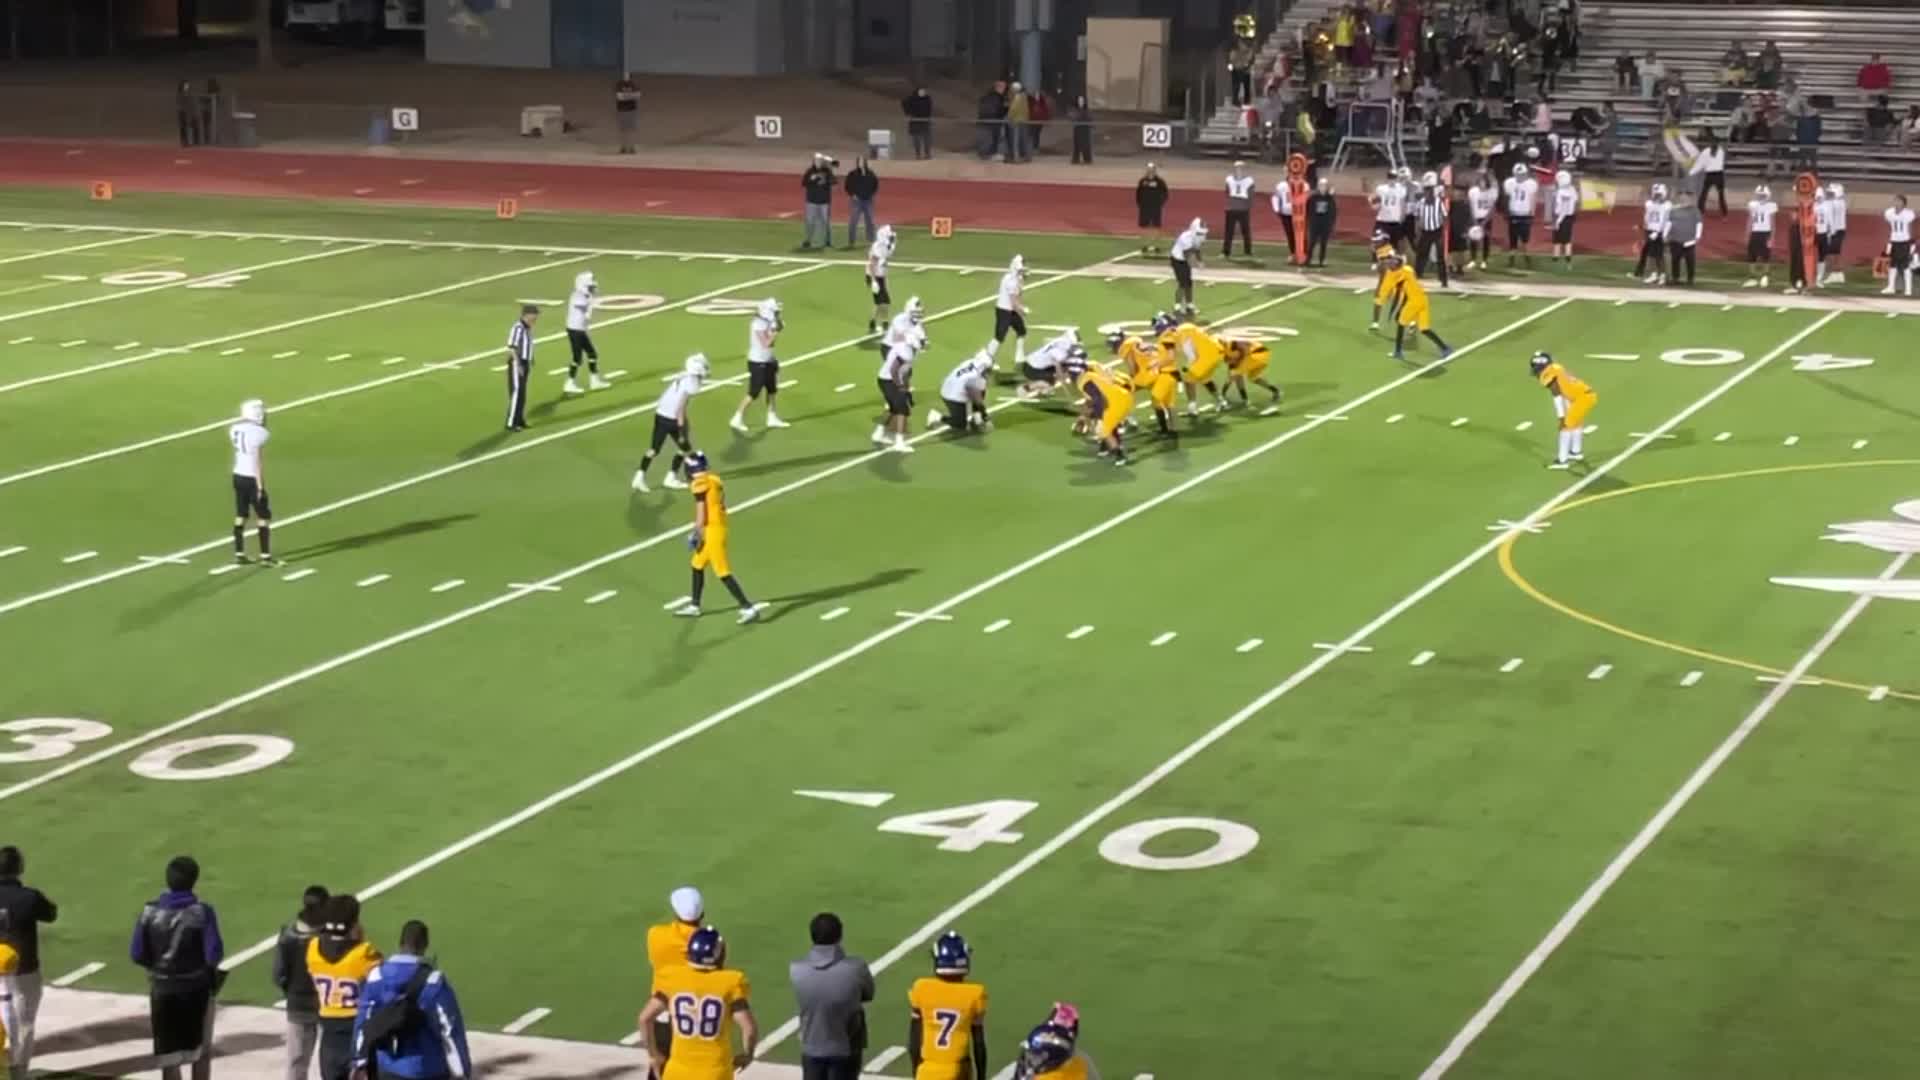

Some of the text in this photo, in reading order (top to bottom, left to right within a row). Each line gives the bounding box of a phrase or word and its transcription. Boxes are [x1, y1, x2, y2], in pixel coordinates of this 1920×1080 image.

[399, 111, 411, 127] G
[760, 119, 778, 135] 10
[1146, 128, 1168, 144] 20
[0, 717, 294, 780] 30
[877, 799, 1260, 869] 40
[315, 977, 359, 1008] 72
[674, 994, 722, 1038] 68
[935, 1009, 958, 1047] 7
